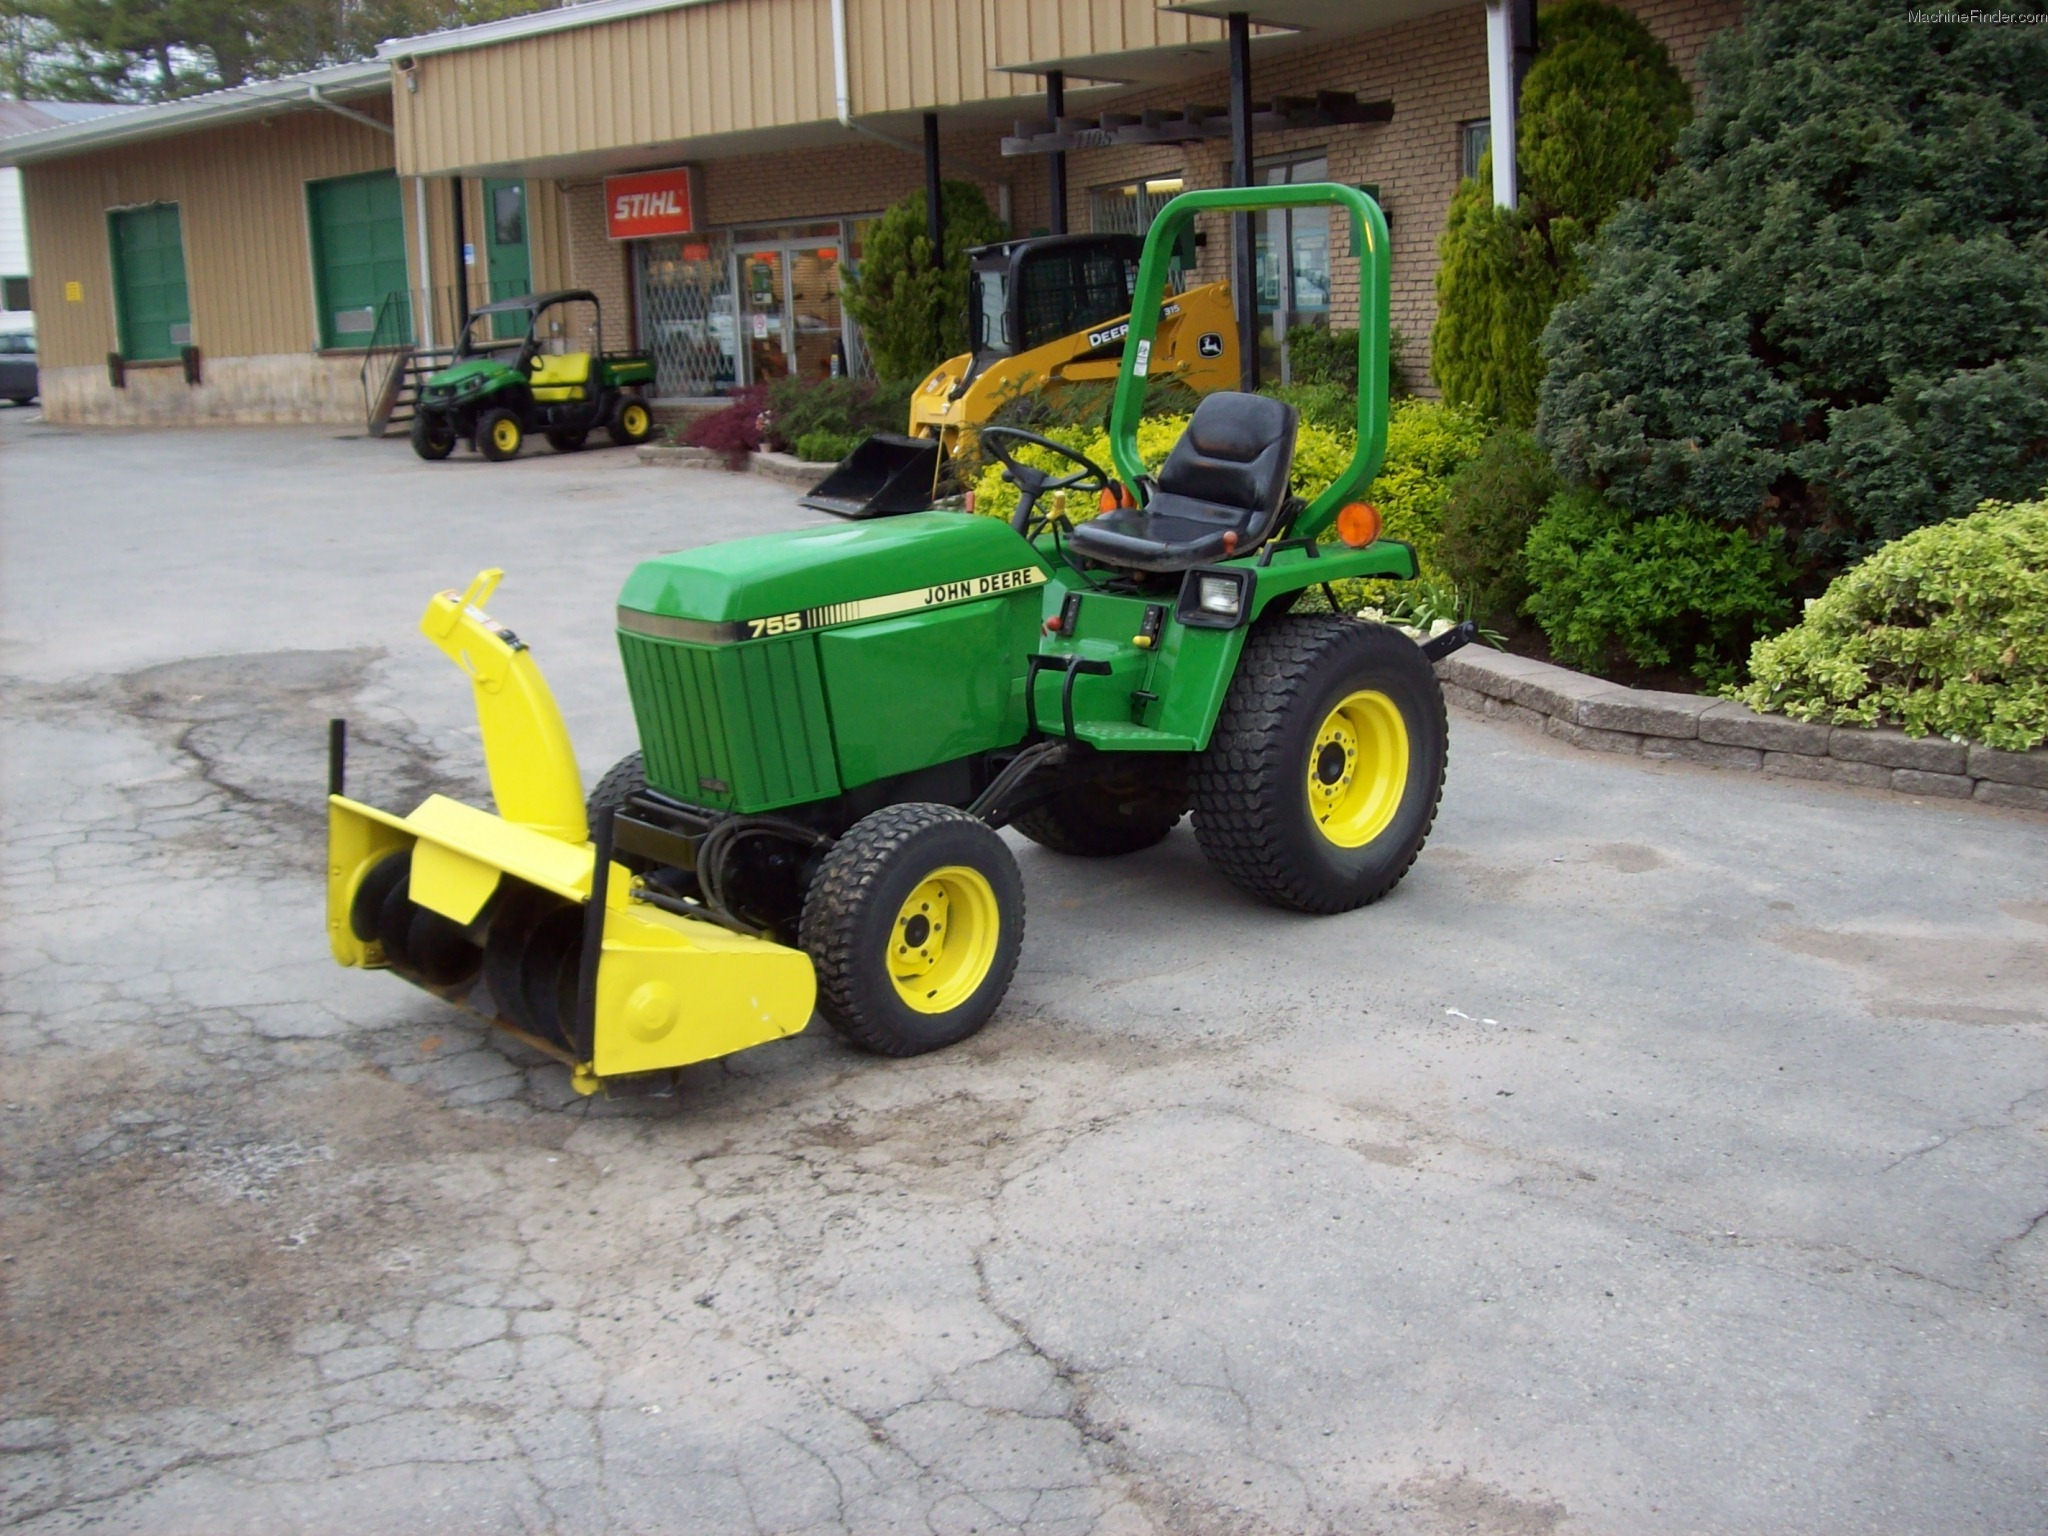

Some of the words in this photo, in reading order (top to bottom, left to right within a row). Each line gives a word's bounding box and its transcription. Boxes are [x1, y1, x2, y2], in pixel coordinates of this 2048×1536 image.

[614, 190, 682, 219] STIHL
[1089, 324, 1130, 347] DEER
[1163, 304, 1180, 316] 315
[748, 612, 801, 638] 755
[924, 581, 971, 605] JOHN
[979, 568, 1032, 593] DEERE
